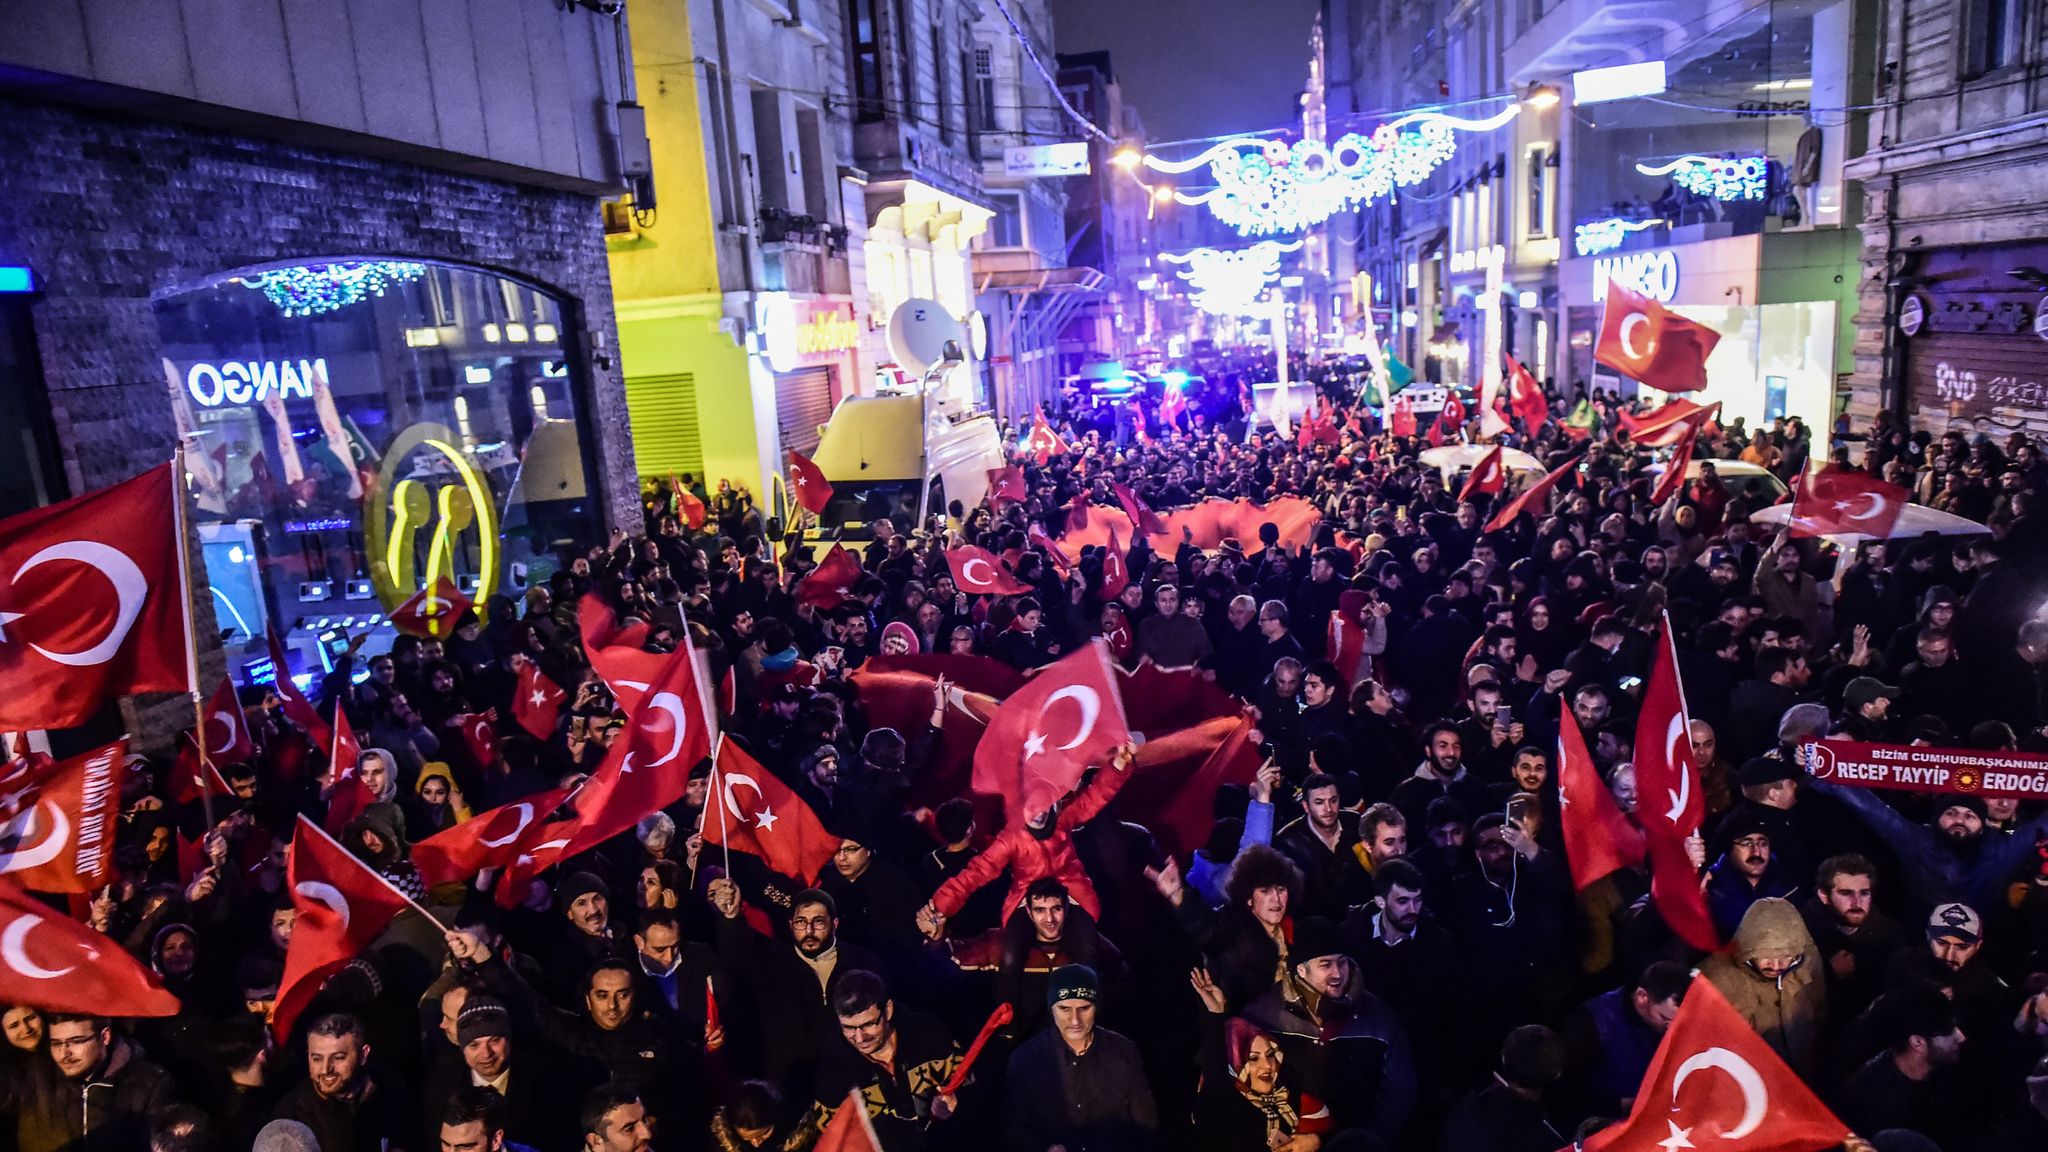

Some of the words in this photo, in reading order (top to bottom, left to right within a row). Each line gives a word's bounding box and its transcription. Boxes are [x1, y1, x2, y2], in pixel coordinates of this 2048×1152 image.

[1872, 749, 1909, 761] BİZİM
[1837, 762, 1889, 781] RECEP
[1892, 765, 1950, 785] TAYYİP
